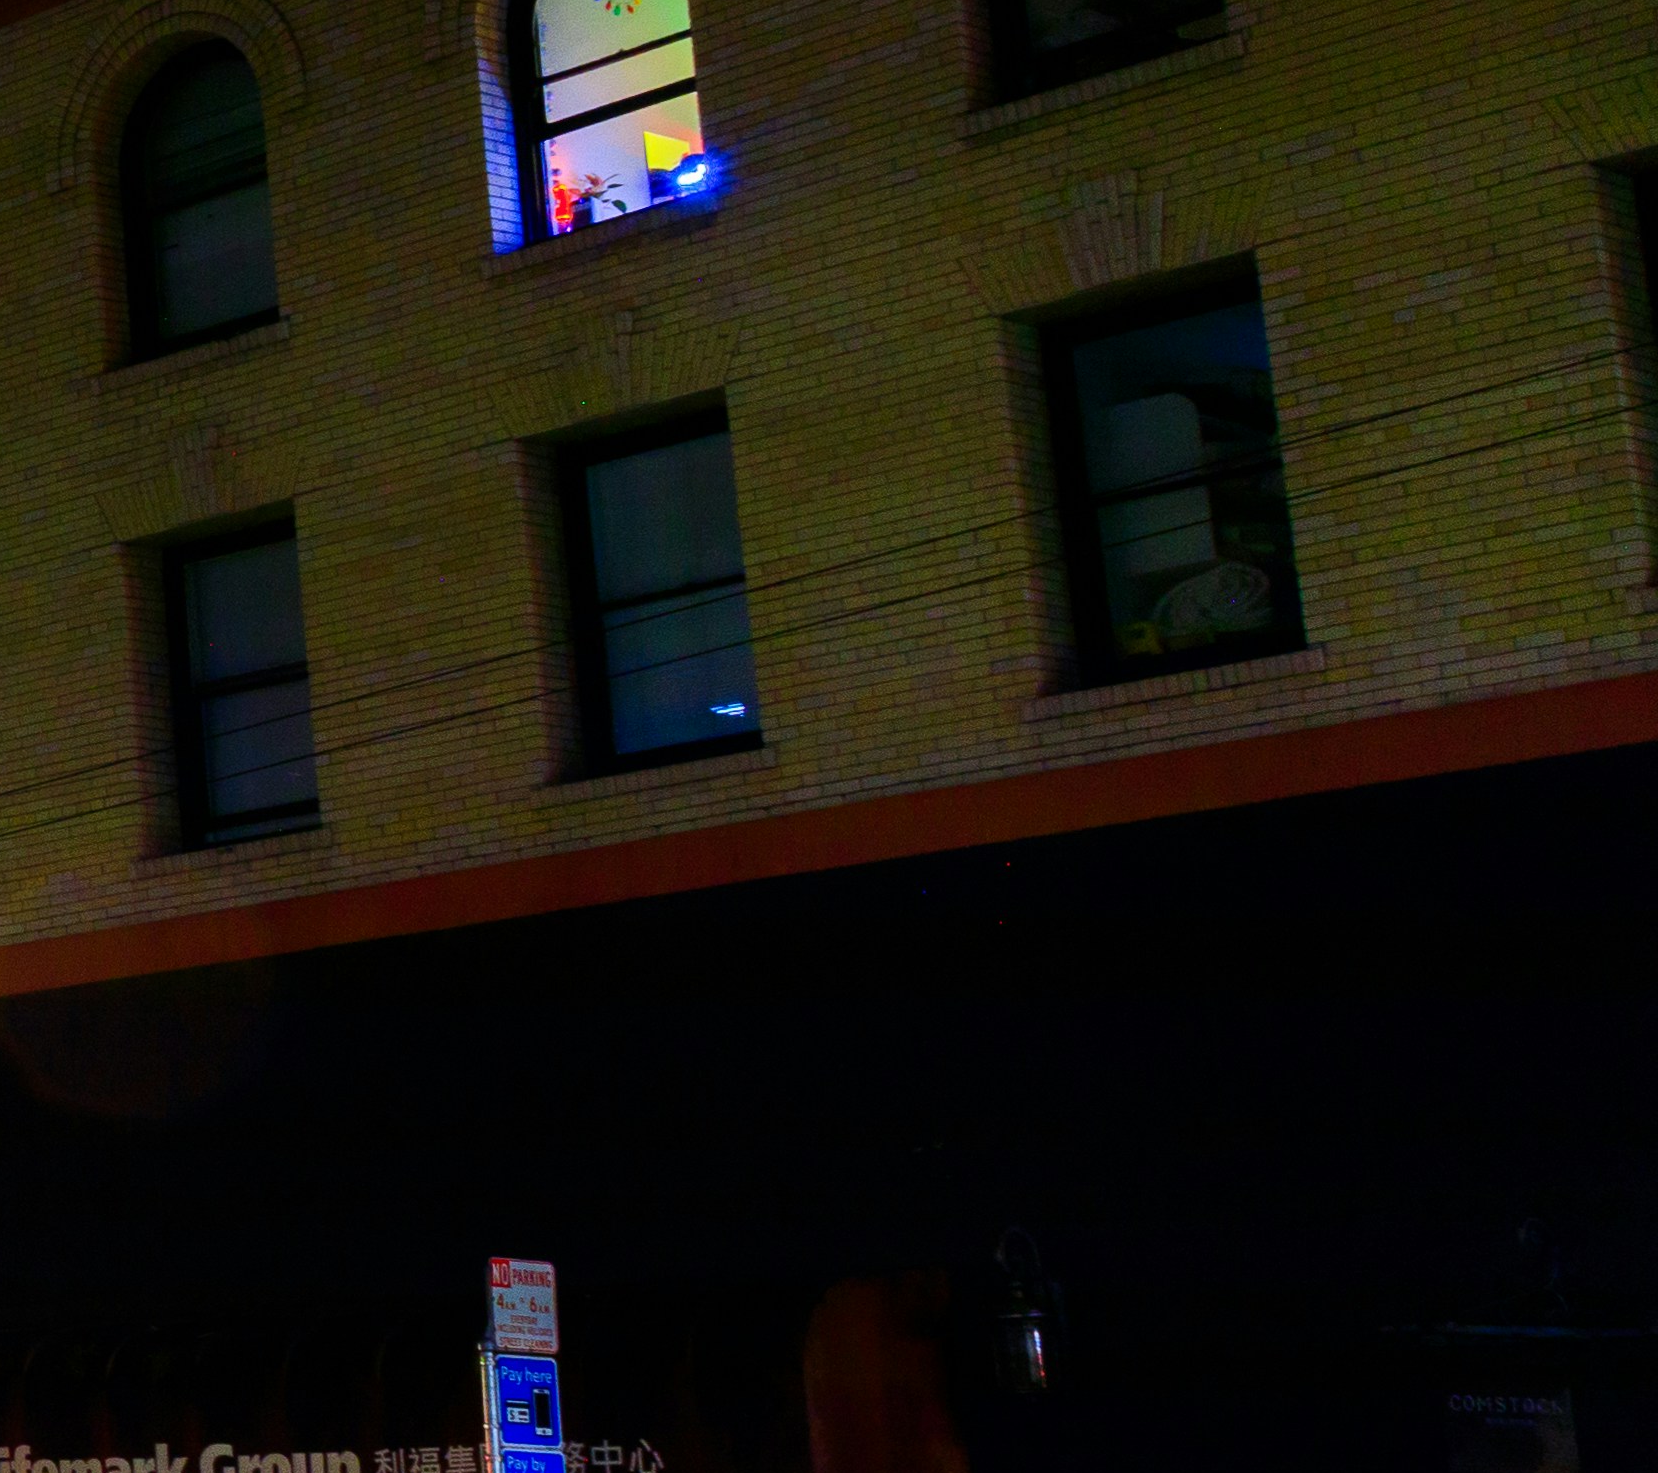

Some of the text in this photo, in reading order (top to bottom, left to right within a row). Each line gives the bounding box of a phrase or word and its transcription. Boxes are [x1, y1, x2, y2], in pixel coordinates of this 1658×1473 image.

[492, 1263, 551, 1287] NO PARKING
[501, 1366, 552, 1385] Pay here
[507, 1455, 527, 1471] Pay
